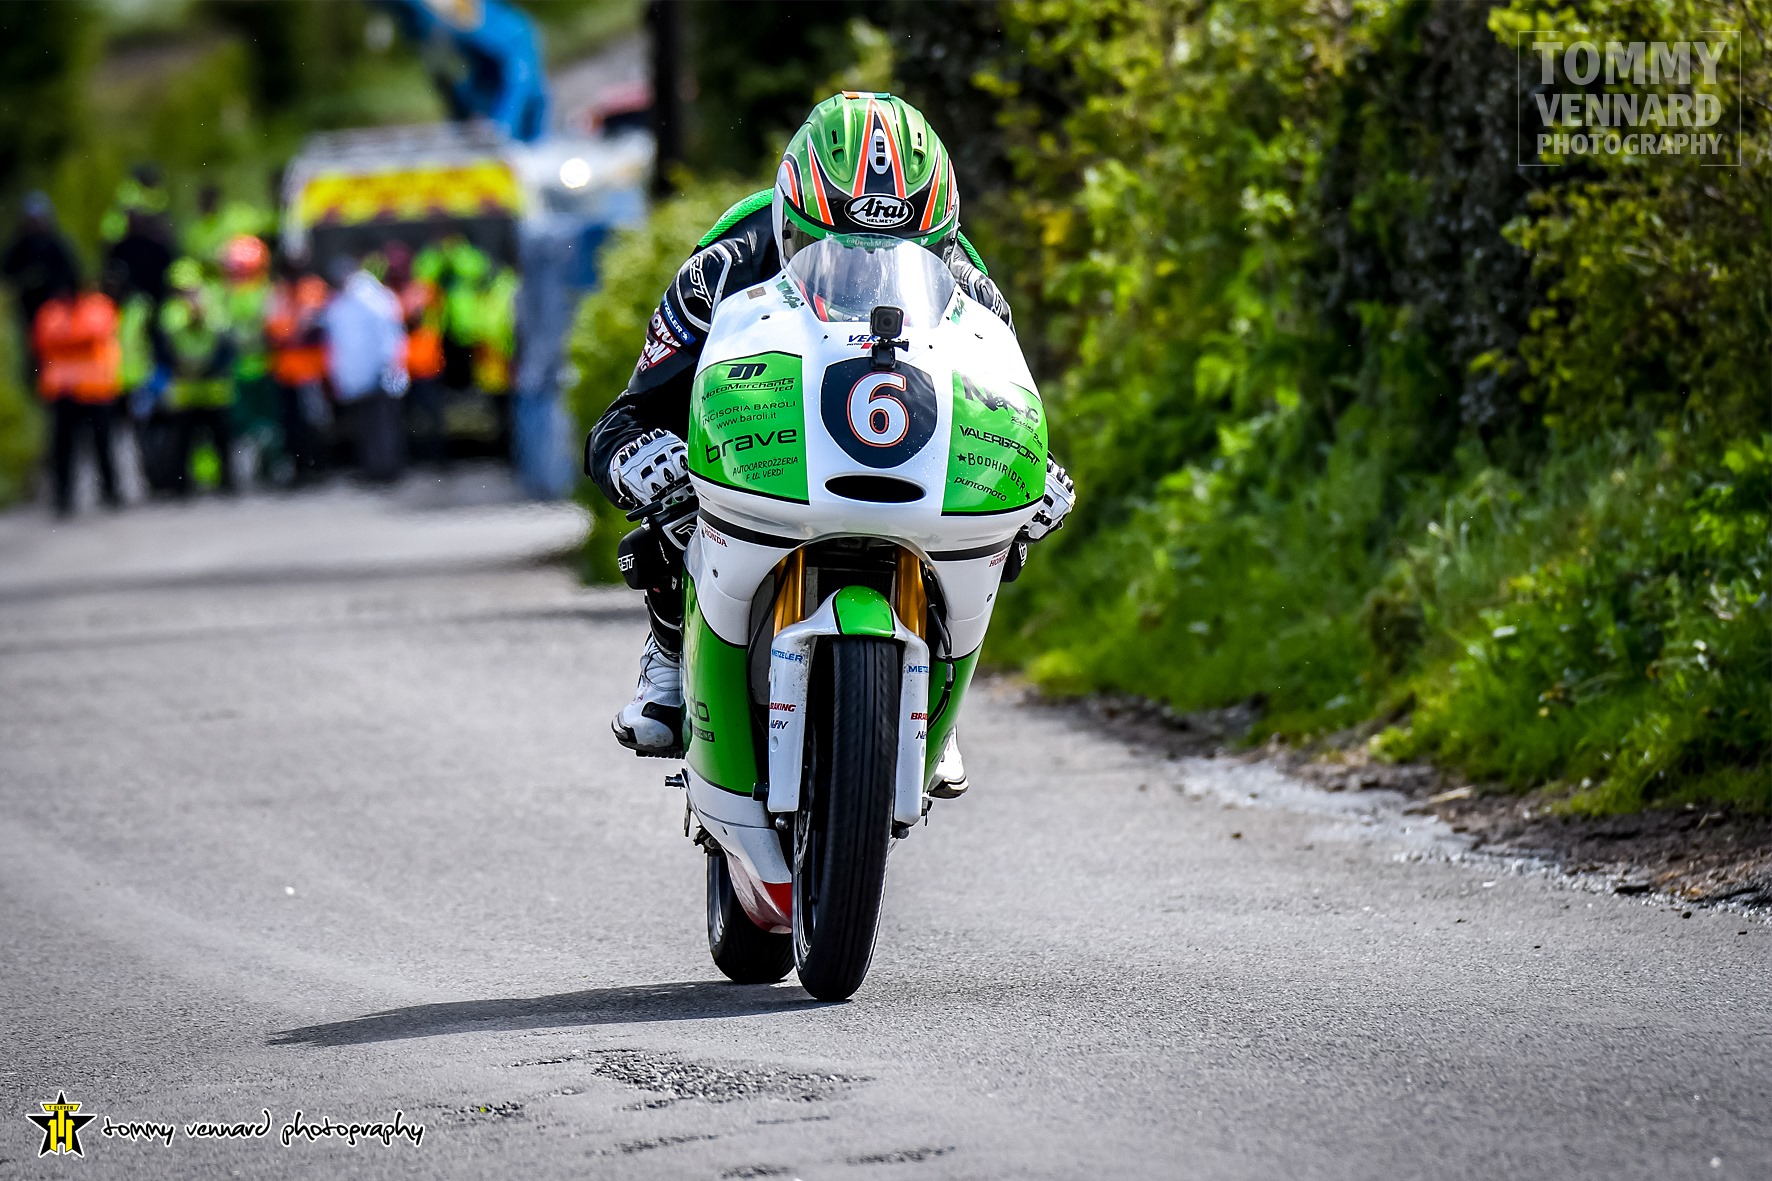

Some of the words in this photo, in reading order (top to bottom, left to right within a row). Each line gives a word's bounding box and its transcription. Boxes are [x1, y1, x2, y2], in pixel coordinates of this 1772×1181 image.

[850, 197, 908, 219] Arai
[663, 301, 683, 334] TZELER
[848, 334, 879, 343] VER
[701, 377, 796, 403] MotoMerchants
[702, 404, 751, 427] INCISORIA
[753, 400, 797, 411] BAROLI
[716, 411, 777, 430] www.baroli.it
[846, 370, 910, 448] 6
[705, 428, 798, 465] brave
[732, 456, 799, 477] AUTOCARROZZERIA
[763, 467, 785, 479] VERDI
[967, 452, 1027, 493] BODHIRIDER
[953, 476, 1008, 502] puntomoto
[704, 527, 729, 548] HONDA
